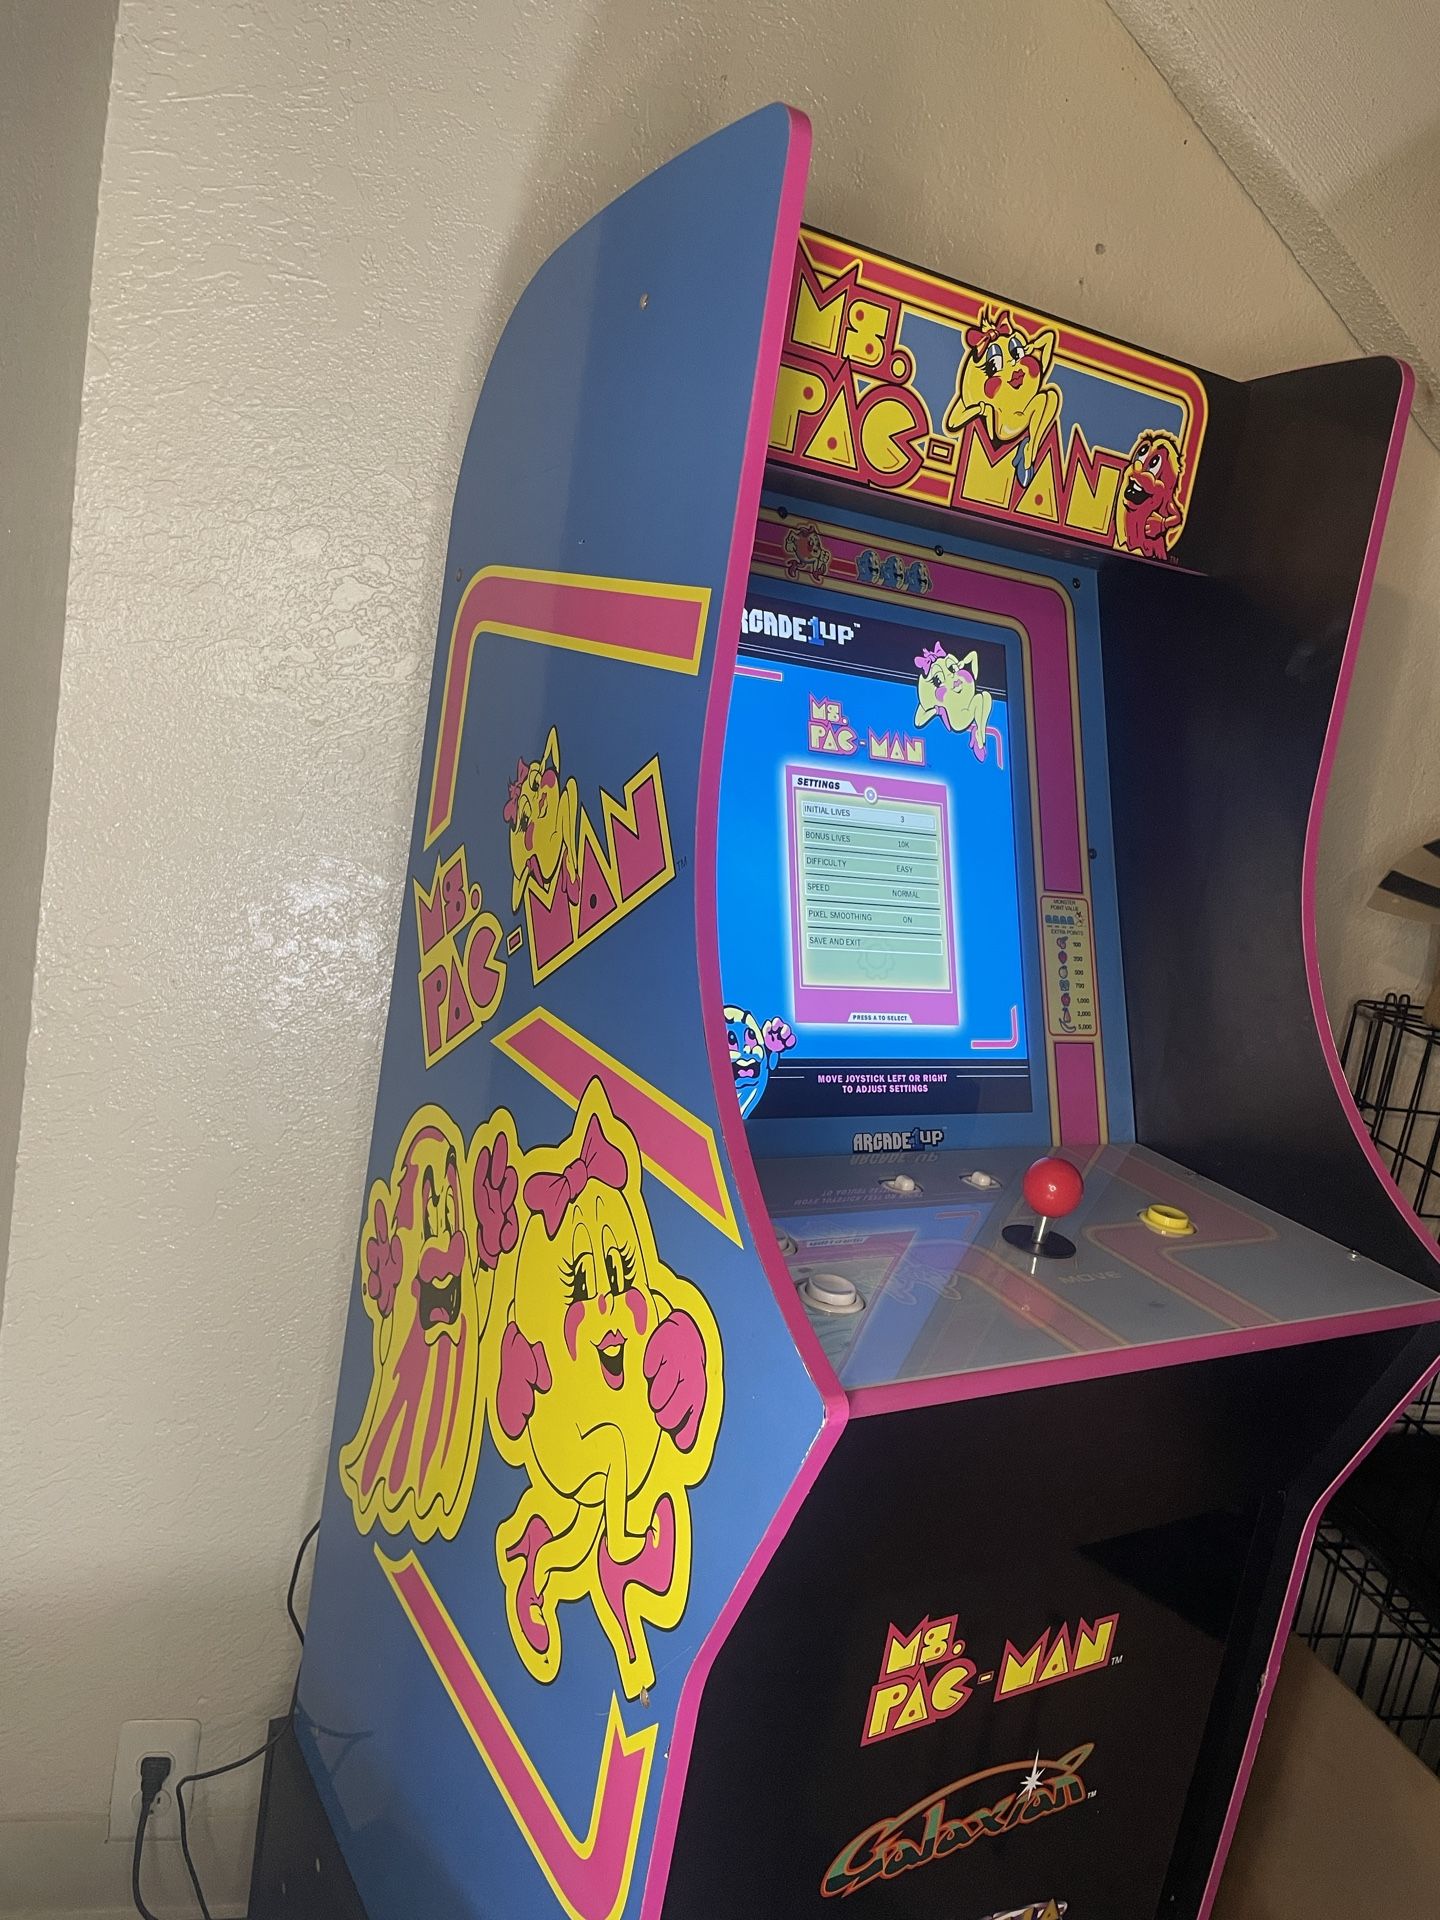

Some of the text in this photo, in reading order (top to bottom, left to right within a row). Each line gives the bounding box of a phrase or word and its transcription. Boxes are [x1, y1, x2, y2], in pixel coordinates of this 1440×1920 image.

[789, 268, 909, 381] MS.
[768, 363, 1122, 537] PAC-MAN
[741, 606, 855, 646] CADE1UP
[809, 695, 848, 725] MS.
[808, 723, 925, 765] PAC-MAN
[797, 777, 841, 790] SETTINGS
[804, 805, 851, 817] INITIAL LIVES
[900, 815, 905, 823] 3
[805, 831, 851, 843] BONUS LIVES
[897, 840, 910, 849] 10K
[806, 856, 847, 868] DIFFICULTY
[896, 864, 913, 874] EASY
[807, 882, 830, 892] SPEED
[892, 889, 920, 899] NORMAL
[415, 850, 481, 956] MS.
[419, 760, 672, 1066] PAC-MAN
[808, 909, 872, 921] PIXEL SMOOTHING
[902, 916, 913, 924] ON
[809, 936, 862, 947] SAVE AND EXIT
[818, 1074, 948, 1083] MOVE JOYSTICK LEFT OR RIGHT
[842, 1084, 929, 1094] TO ADJUST SETTINGS
[853, 1127, 944, 1152] ARCADE1UP
[880, 1616, 966, 1680] MS.
[862, 1615, 1117, 1744] PAC-MAN
